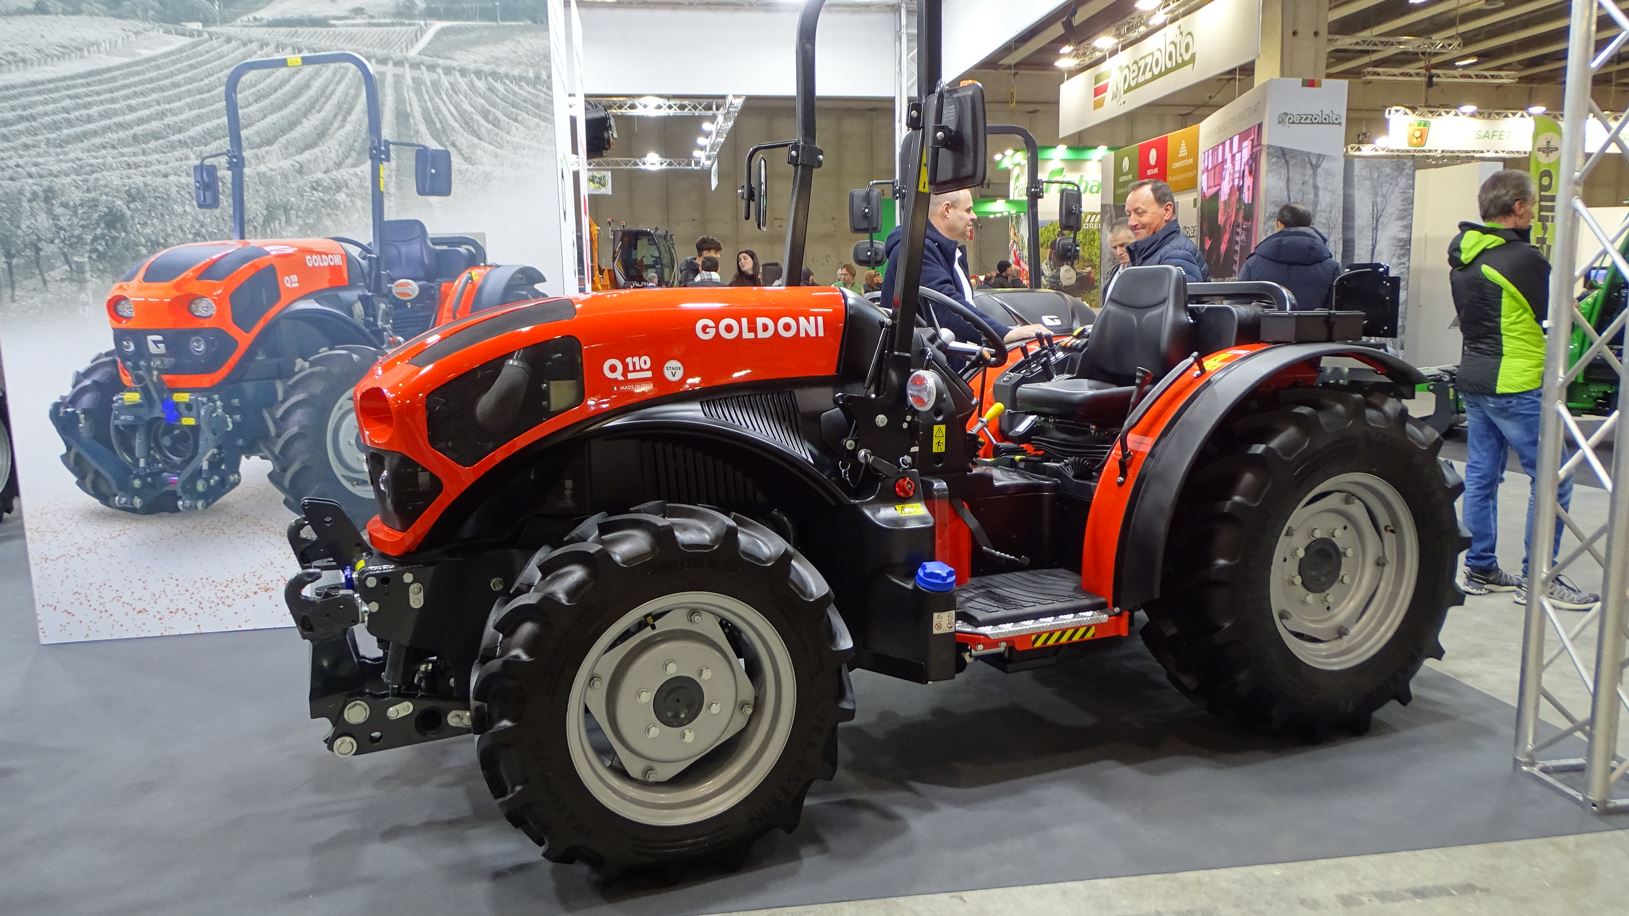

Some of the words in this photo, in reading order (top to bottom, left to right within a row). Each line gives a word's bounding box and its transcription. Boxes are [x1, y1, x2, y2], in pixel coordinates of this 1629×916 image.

[1121, 25, 1195, 91] pezzolato
[1286, 110, 1342, 124] pezzolato
[305, 253, 343, 267] GOLDONI
[695, 316, 824, 340] GOLDONI
[603, 358, 624, 380] Q
[625, 355, 651, 370] 110
